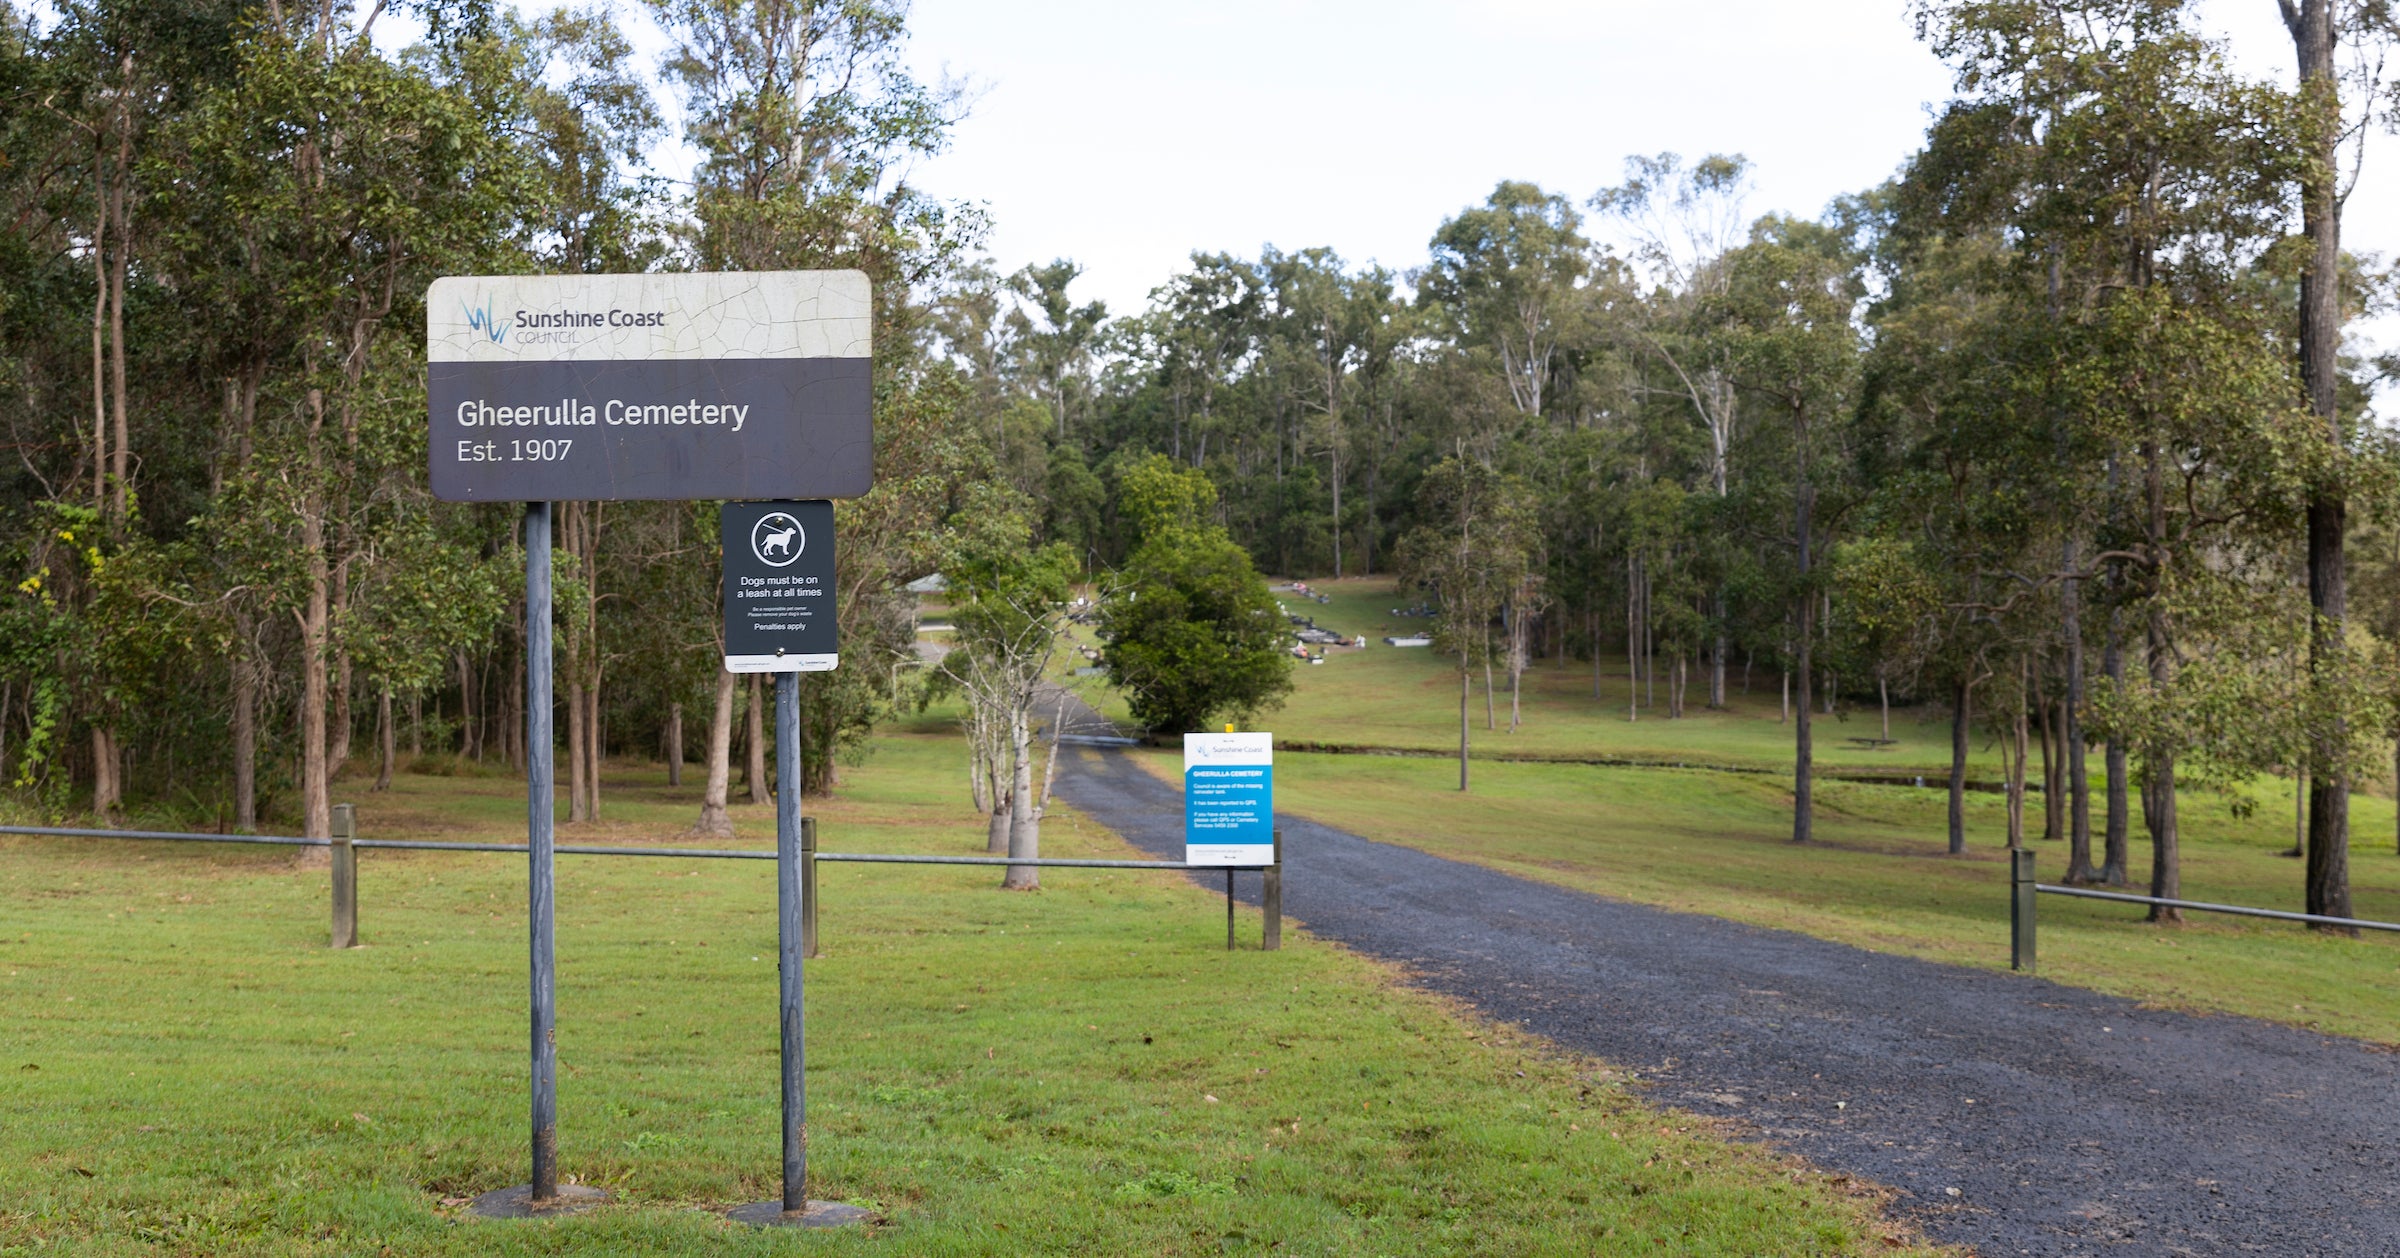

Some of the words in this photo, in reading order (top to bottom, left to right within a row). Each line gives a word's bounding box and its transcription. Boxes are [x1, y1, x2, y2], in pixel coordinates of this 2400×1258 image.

[515, 309, 605, 328] Sunshine
[608, 309, 665, 328] Coast
[515, 331, 580, 344] COUNCIL
[457, 399, 597, 427] Gheerulla
[604, 398, 749, 432] Cemetery
[457, 440, 503, 461] Est.
[511, 439, 573, 461] 1907
[740, 576, 765, 587] Dogs
[767, 576, 790, 585] must
[791, 576, 804, 584] be
[805, 576, 818, 584] on
[737, 590, 744, 598] a
[745, 589, 770, 597] leash
[772, 588, 782, 597] at
[784, 588, 795, 597] all
[796, 588, 822, 597] times
[754, 623, 786, 631] Penalties
[787, 622, 806, 631] apply
[1212, 745, 1243, 753] Sunshine
[1243, 745, 1263, 753] Coast
[1193, 770, 1230, 778] GHEERULLA
